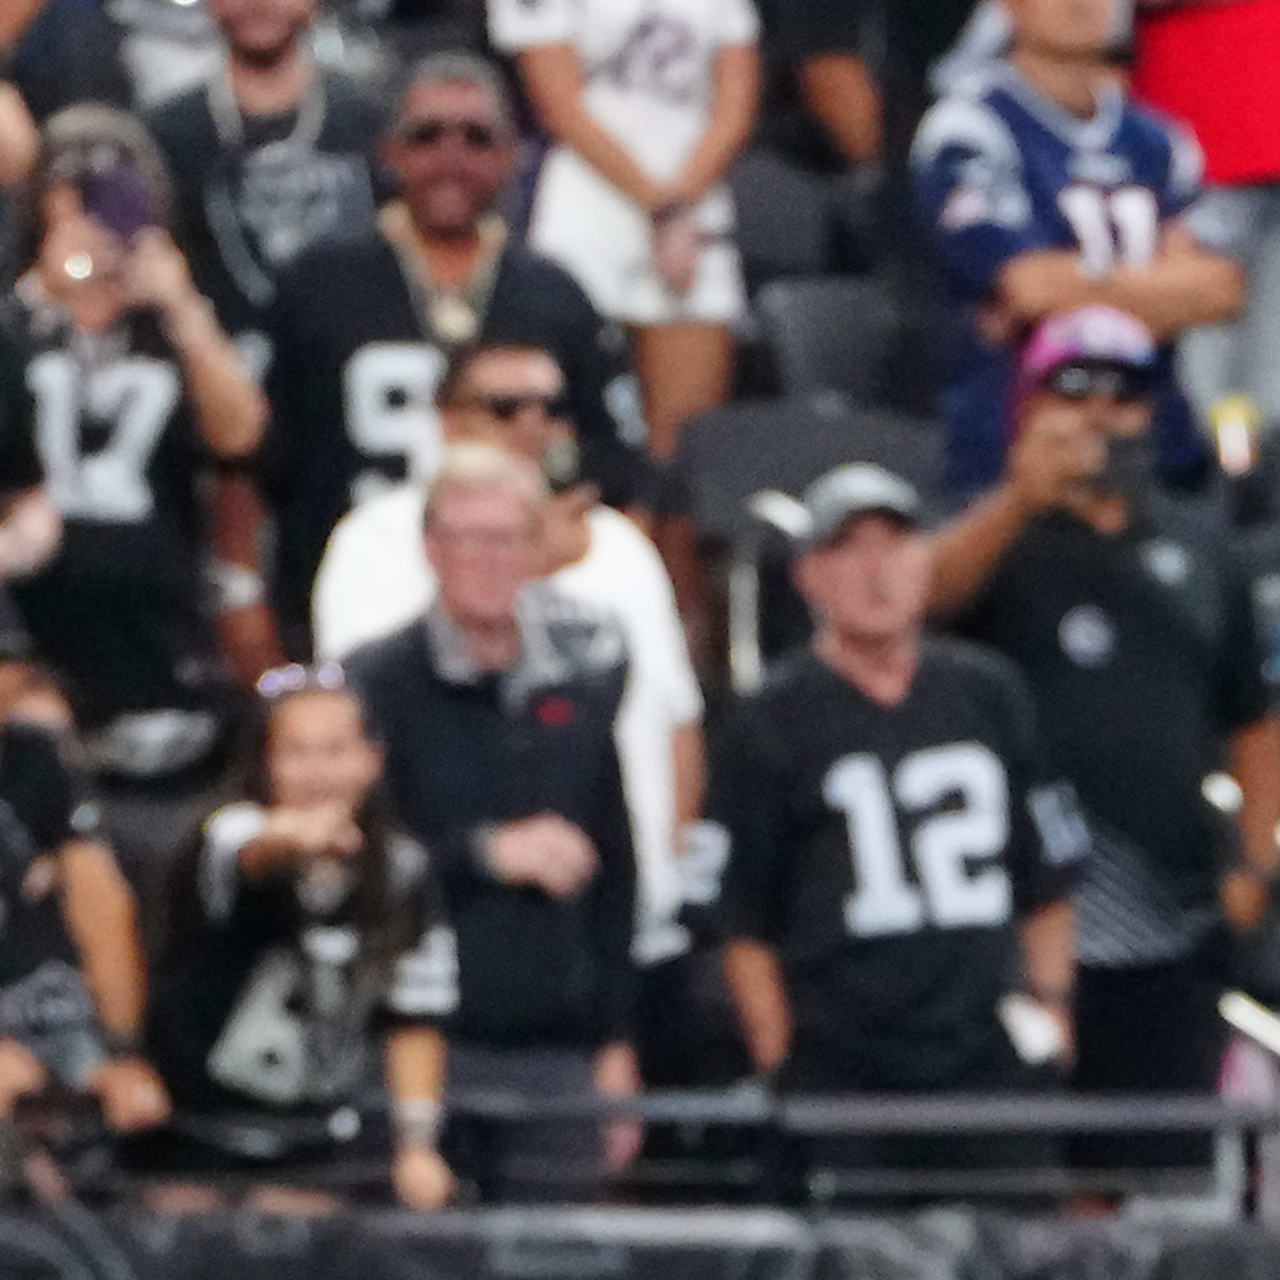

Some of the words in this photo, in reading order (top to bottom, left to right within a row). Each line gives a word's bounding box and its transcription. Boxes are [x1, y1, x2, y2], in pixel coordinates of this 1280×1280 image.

[25, 345, 182, 521] 17
[343, 340, 450, 505] 9
[822, 739, 1014, 938] 12
